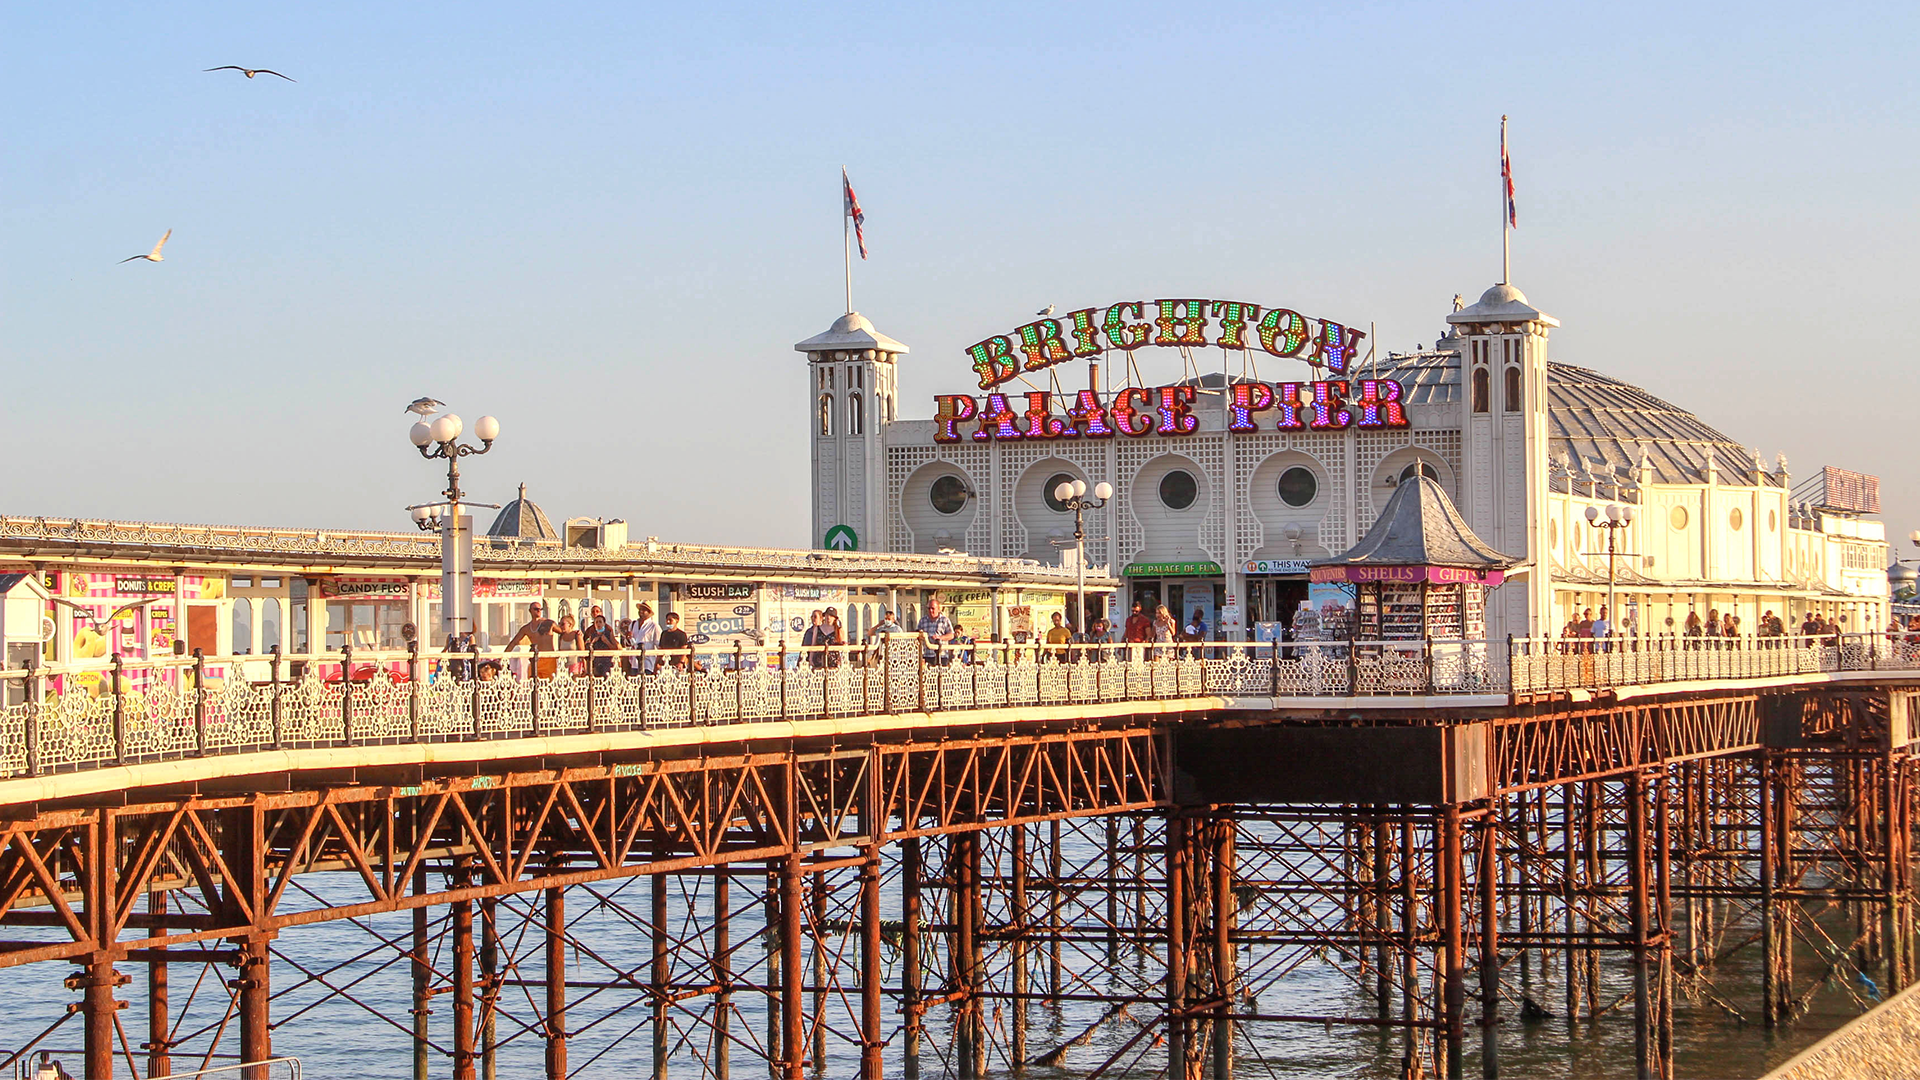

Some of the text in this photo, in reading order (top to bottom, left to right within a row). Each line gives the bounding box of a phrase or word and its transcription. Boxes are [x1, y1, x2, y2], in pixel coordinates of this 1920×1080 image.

[966, 298, 1366, 390] BRIGHTON
[933, 379, 1411, 444] PALACE PIER
[1128, 564, 1217, 574] THE PALACE OF FUN
[1310, 567, 1346, 581] SOUVENIRS
[1359, 567, 1414, 580] SHELLS
[1439, 568, 1478, 582] GIFTS
[117, 581, 175, 592] DONUTS & CREPE
[340, 584, 409, 593] CANDY FLOS
[691, 587, 749, 597] SLUSH BAR
[795, 588, 820, 598] SLUSH BAR
[949, 594, 964, 604] ICE
[1007, 605, 1031, 616] LOVE
[698, 613, 718, 621] GET
[700, 619, 743, 634] COOL!
